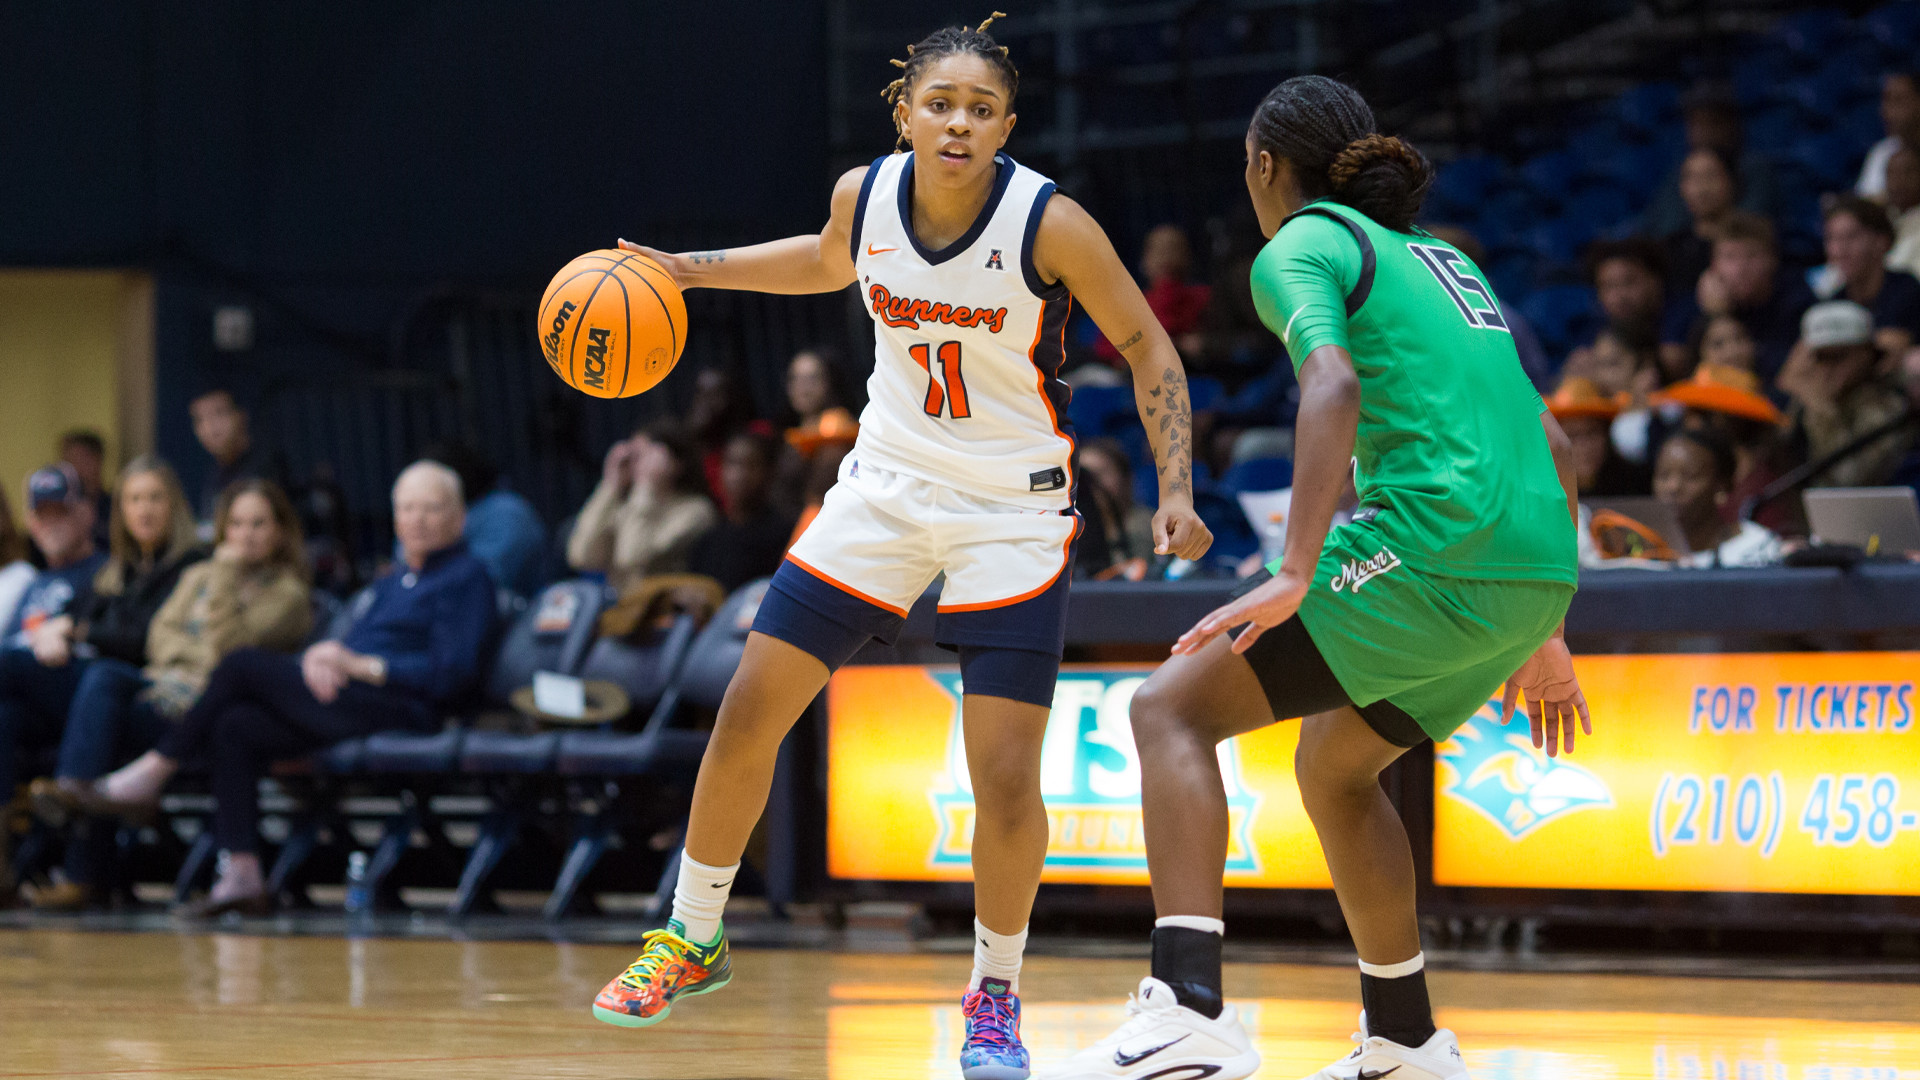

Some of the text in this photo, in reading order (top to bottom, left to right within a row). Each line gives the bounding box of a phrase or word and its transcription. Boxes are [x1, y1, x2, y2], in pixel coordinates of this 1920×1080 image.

[1407, 243, 1510, 332] 15
[584, 328, 611, 390] NCAA
[908, 340, 972, 419] 11
[1691, 684, 1914, 730] FOR TICKETS
[1653, 775, 1916, 856] (210) 458-
